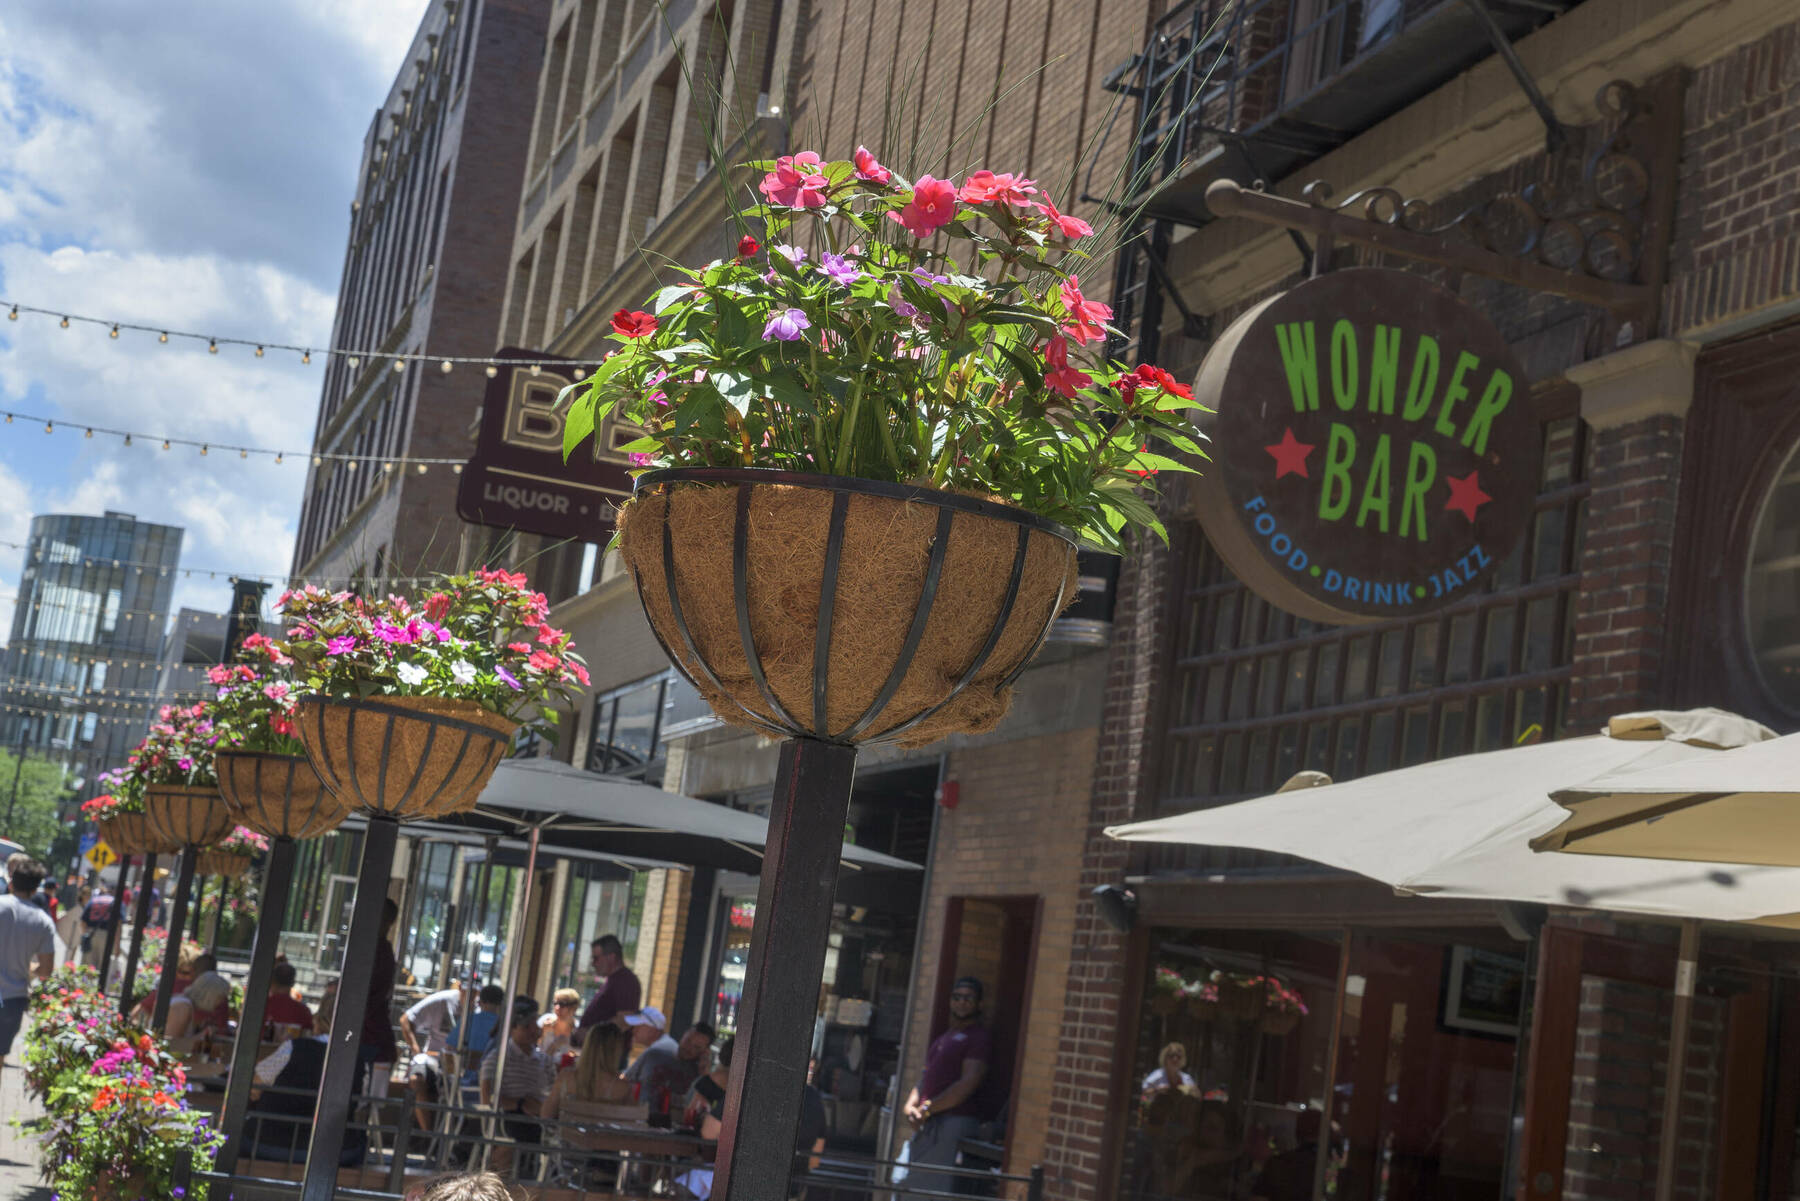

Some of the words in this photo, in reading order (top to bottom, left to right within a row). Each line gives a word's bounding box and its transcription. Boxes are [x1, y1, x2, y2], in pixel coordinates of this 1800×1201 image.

[1274, 319, 1513, 457] WONDER
[483, 483, 570, 514] LIQUOR
[1319, 422, 1437, 541] BAR
[1244, 495, 1308, 572] FOOD
[1322, 569, 1412, 605] DRINK
[1429, 544, 1491, 597] JAZZ
